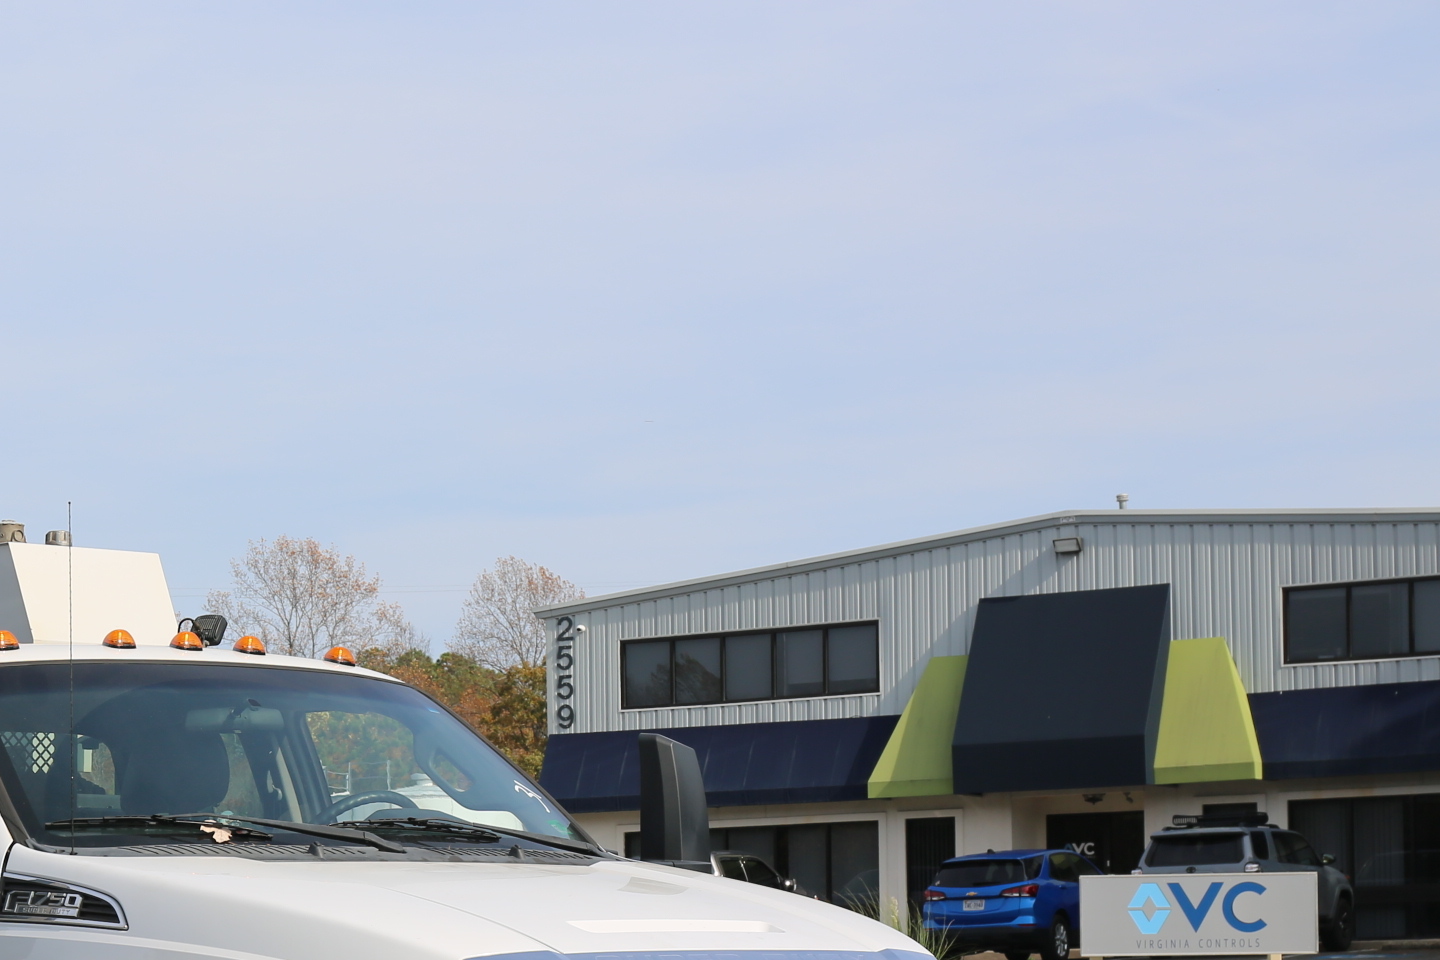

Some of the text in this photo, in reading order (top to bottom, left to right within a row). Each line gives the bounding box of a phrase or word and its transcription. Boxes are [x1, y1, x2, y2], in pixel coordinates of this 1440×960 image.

[556, 616, 574, 729] 2559
[1167, 881, 1267, 933] VC
[1136, 937, 1261, 949] VIRGINIA CONTROLS
